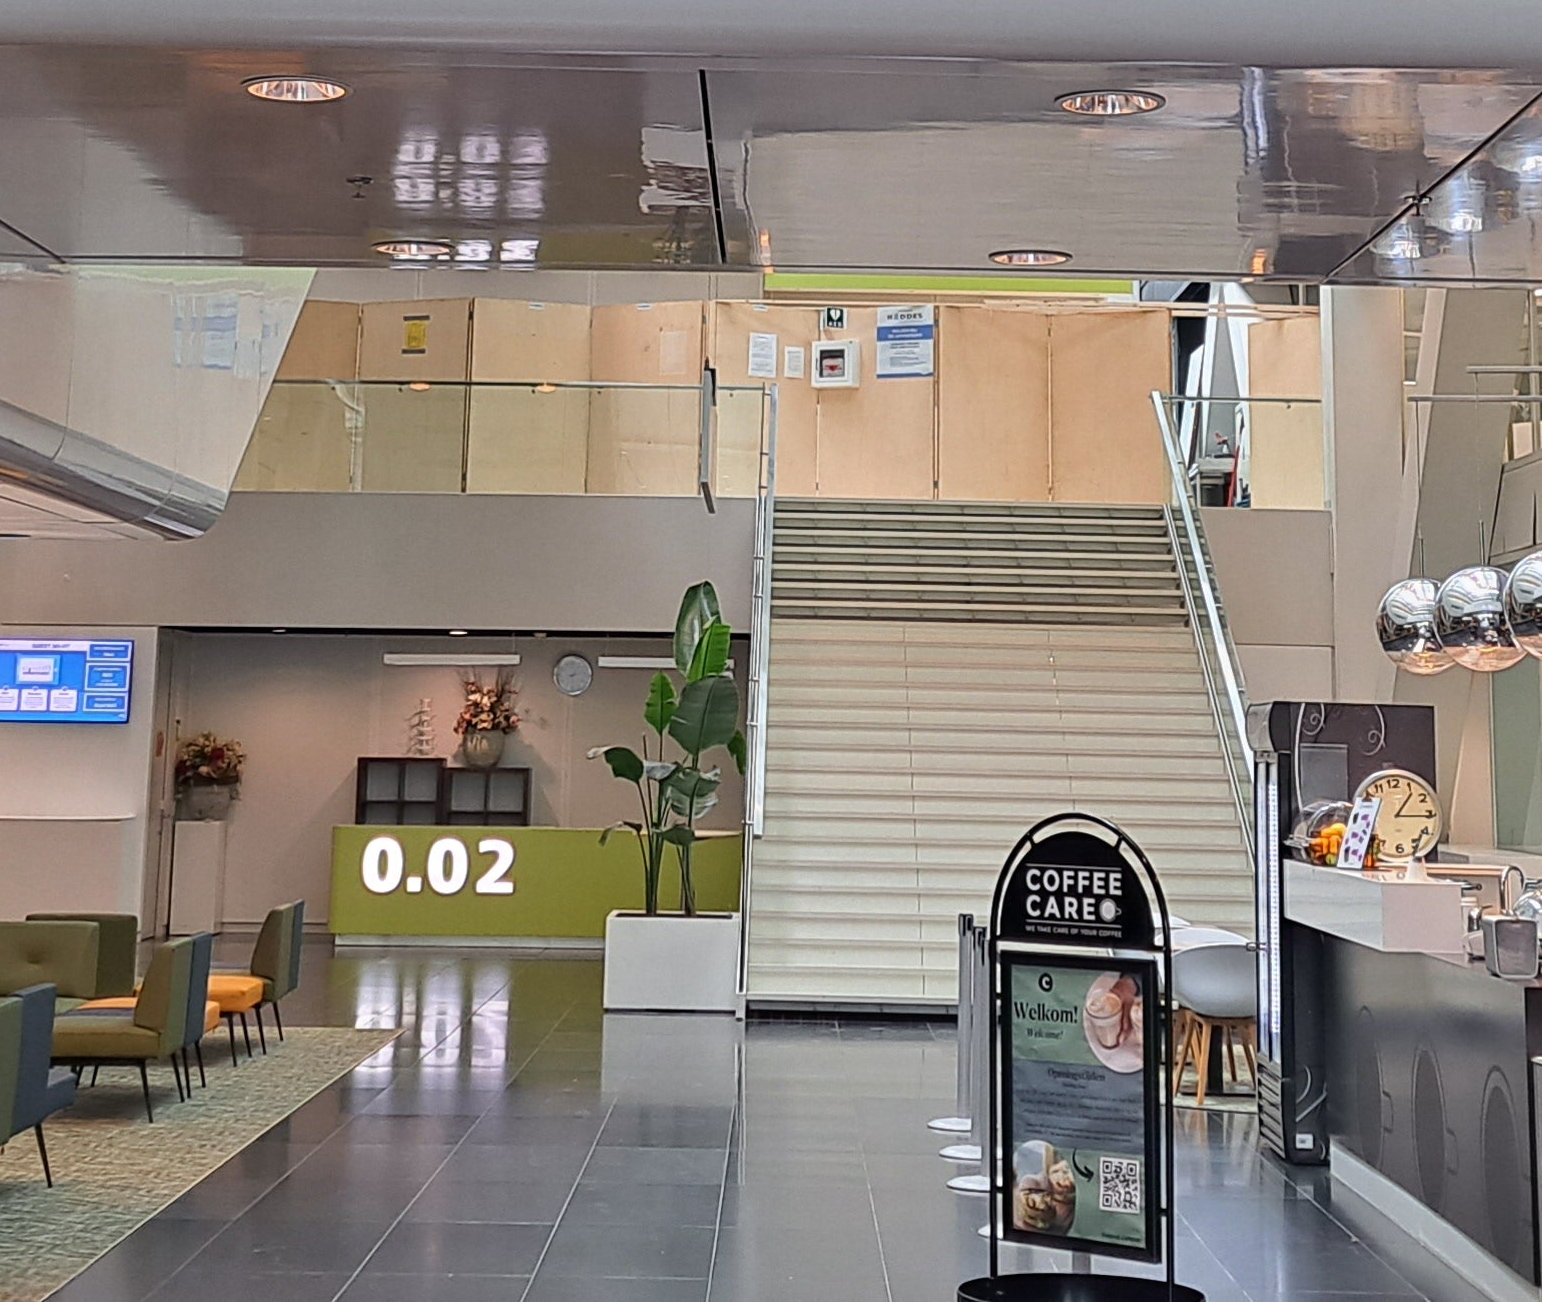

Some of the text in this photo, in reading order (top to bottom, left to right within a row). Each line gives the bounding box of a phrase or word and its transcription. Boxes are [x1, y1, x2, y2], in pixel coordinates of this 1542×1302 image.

[1374, 784, 1384, 793] 11
[1387, 779, 1400, 788] 12
[1418, 793, 1427, 803] 2
[1395, 844, 1405, 853] 6
[362, 836, 515, 895] 0.02
[1026, 869, 1122, 895] COFFEE
[1026, 895, 1096, 920] CARE
[1037, 925, 1051, 933] TAKE
[1053, 926, 1068, 934] CARE
[1070, 927, 1079, 935] OF
[1080, 928, 1097, 936] YOUR
[1099, 930, 1122, 938] COFFEE
[1014, 1002, 1078, 1024] Welkom!
